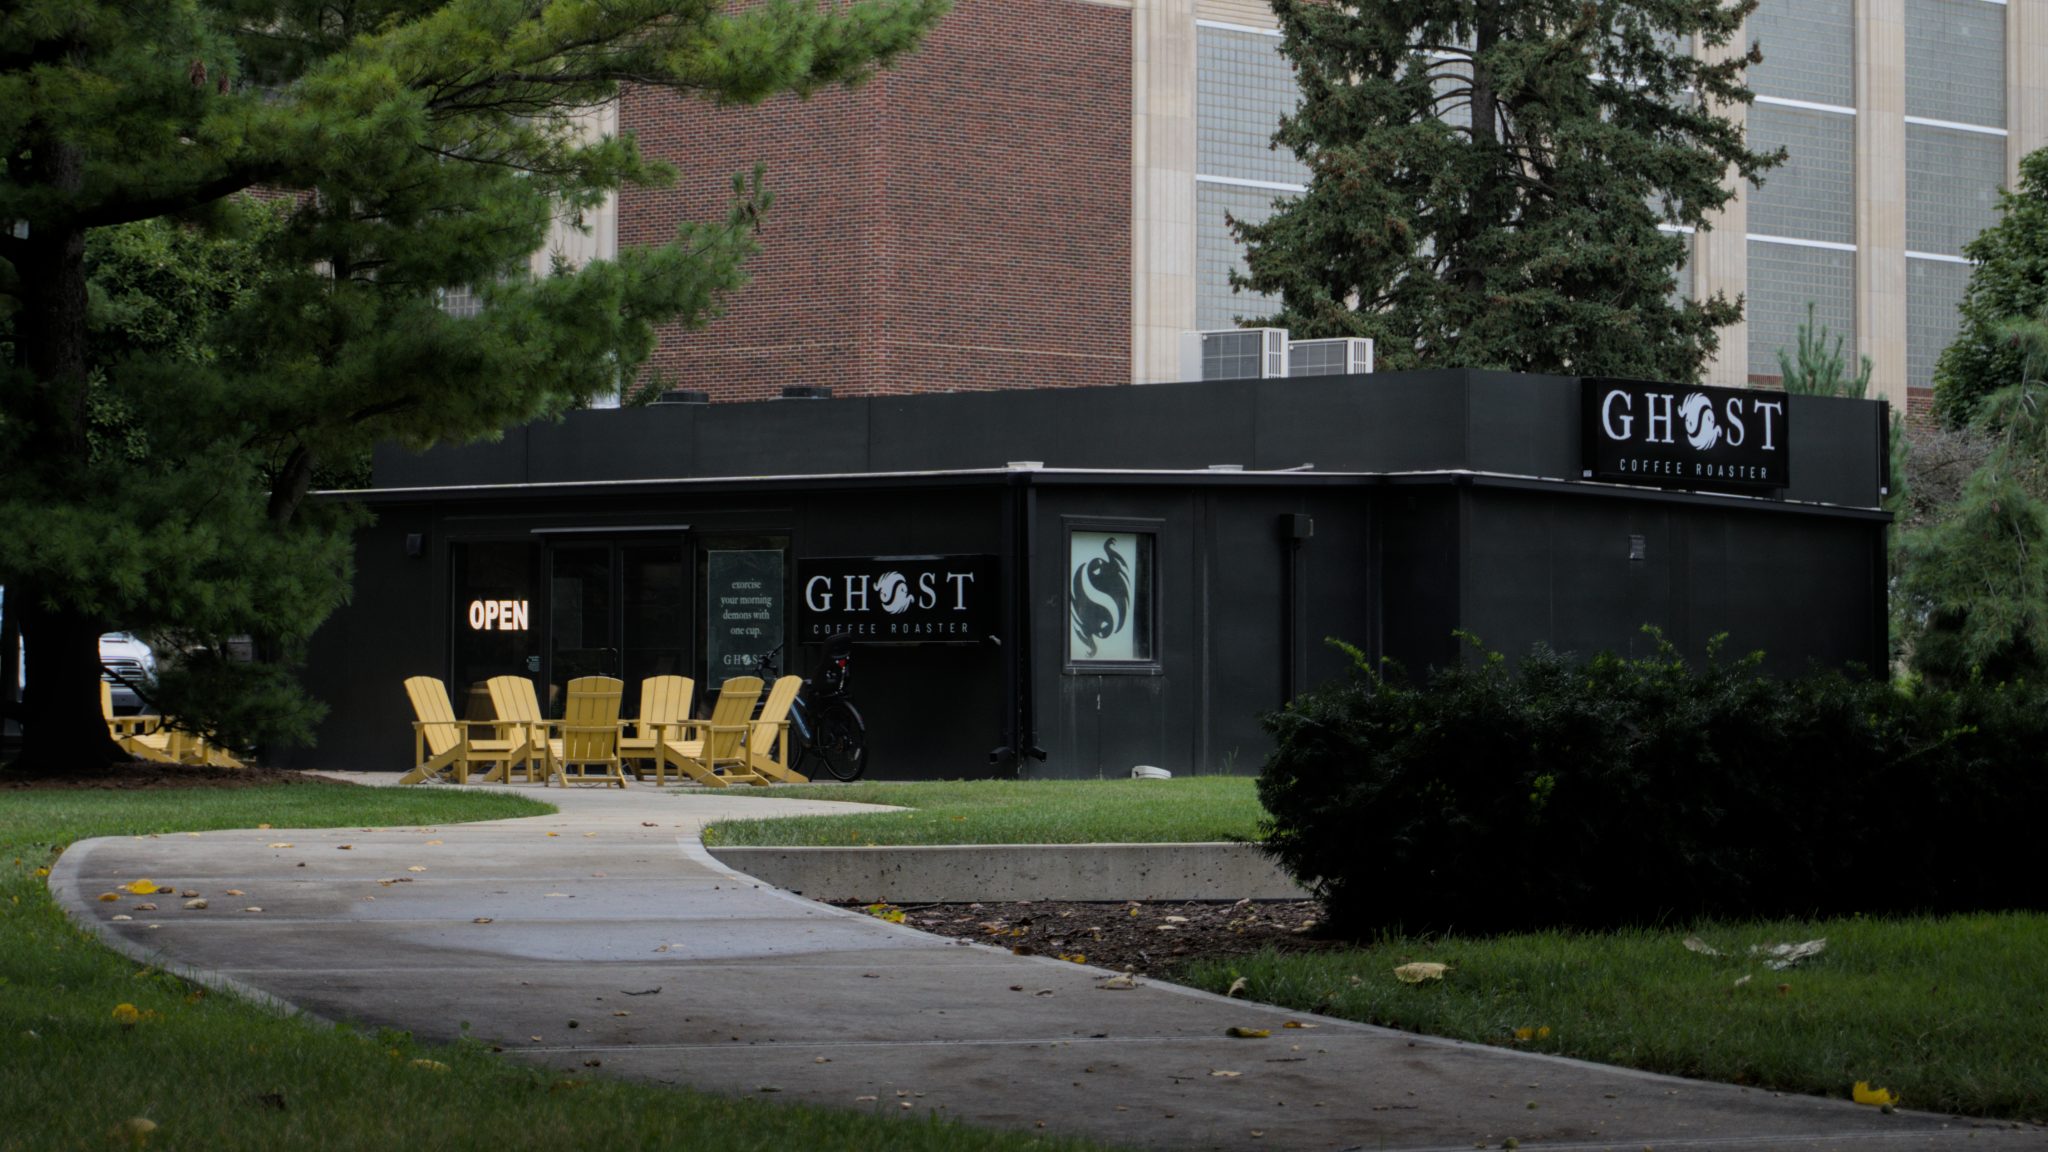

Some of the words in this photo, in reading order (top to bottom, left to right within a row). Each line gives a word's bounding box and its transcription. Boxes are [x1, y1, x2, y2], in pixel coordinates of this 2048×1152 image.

[1602, 389, 1782, 450] GHOST
[1620, 458, 1682, 475] COFFEE
[1696, 463, 1767, 480] ROASTER
[731, 578, 762, 589] exorcise
[720, 597, 739, 608] your
[739, 593, 772, 608] morning
[805, 571, 975, 615] GHOST
[469, 600, 529, 630] OPEN
[723, 608, 752, 620] demons
[753, 608, 770, 620] with
[730, 627, 745, 635] one
[745, 627, 762, 638] cup.
[813, 623, 877, 635] COFFEE
[891, 622, 968, 634] ROASTER
